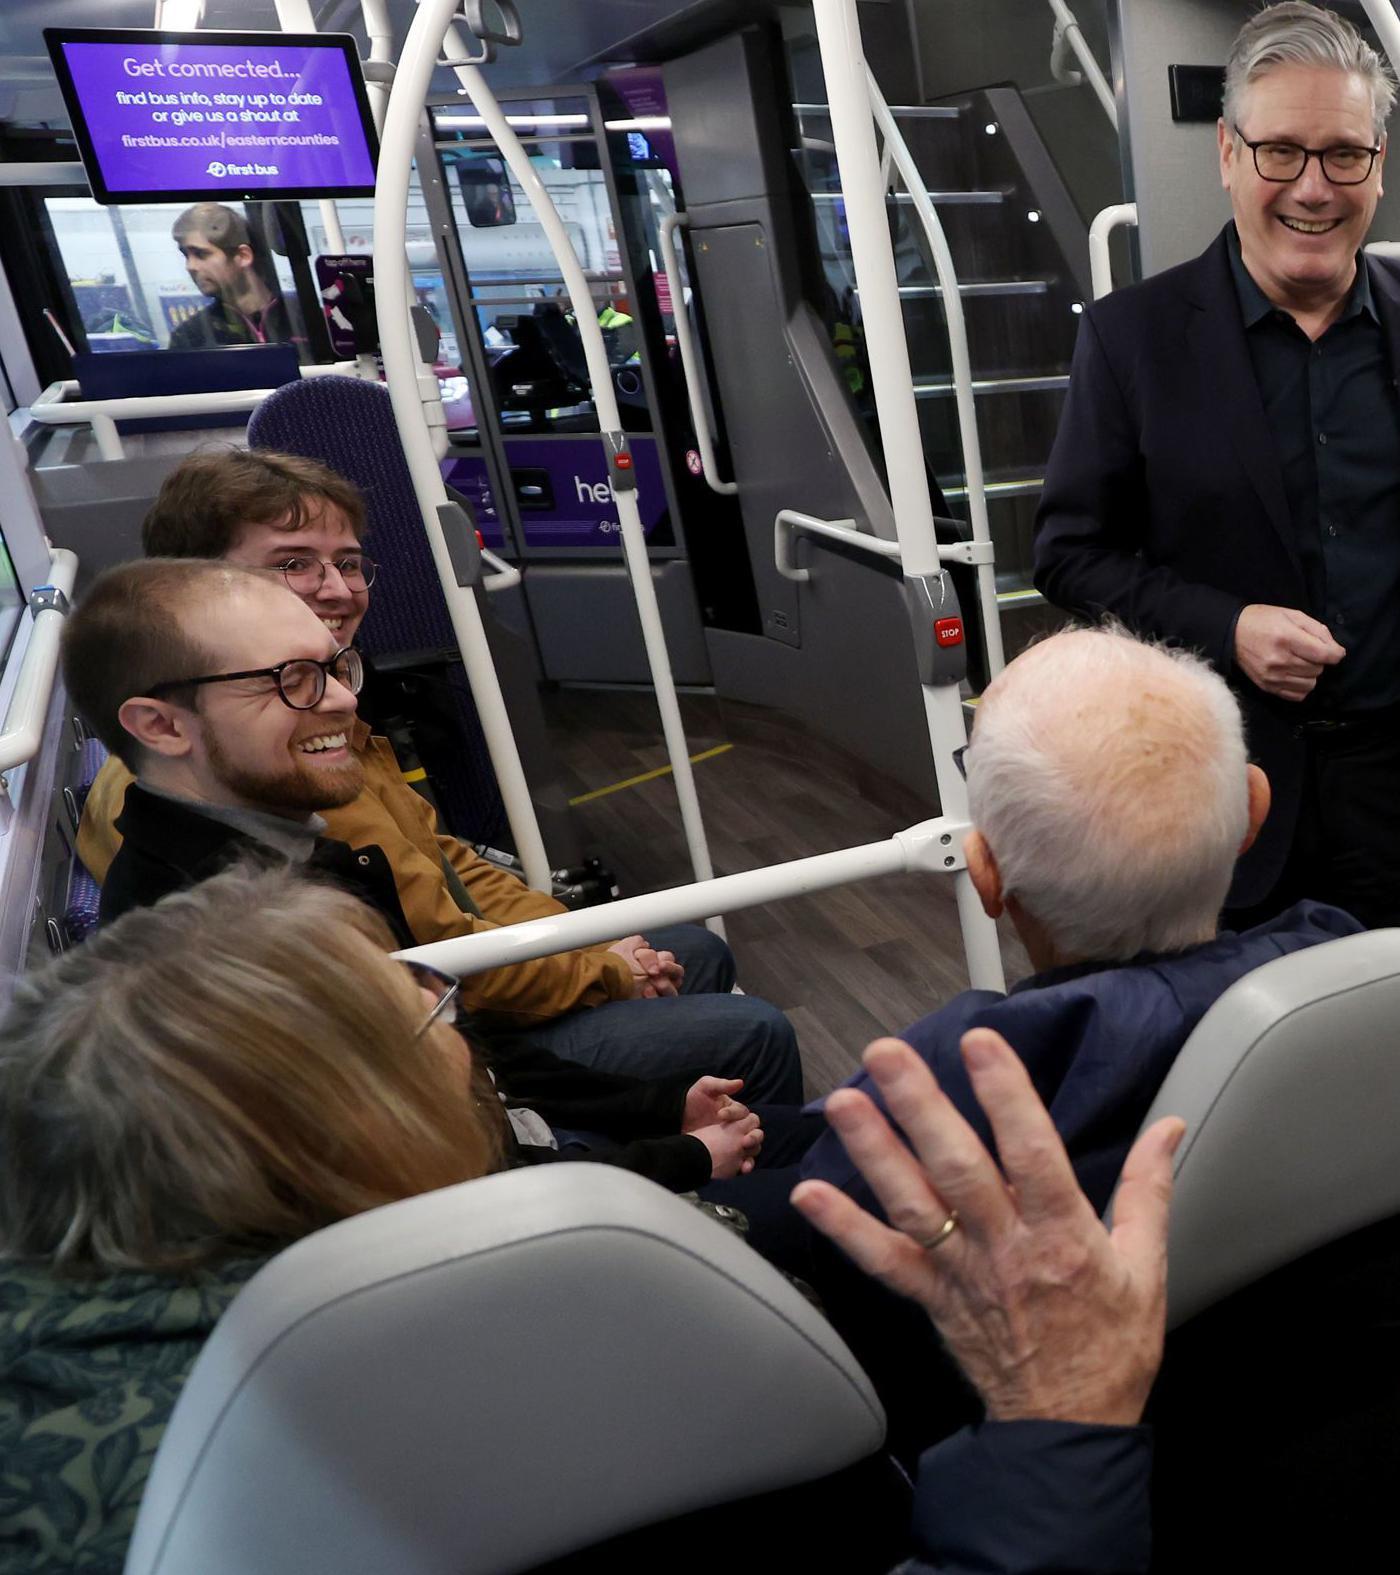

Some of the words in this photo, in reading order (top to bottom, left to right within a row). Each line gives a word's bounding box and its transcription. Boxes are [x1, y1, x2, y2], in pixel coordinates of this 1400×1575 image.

[123, 58, 165, 77] Get
[168, 60, 301, 78] connected...
[116, 91, 146, 105] find
[149, 92, 178, 105] bus
[180, 92, 212, 107] info,
[214, 94, 244, 108] stay
[247, 95, 269, 108] up
[270, 93, 286, 105] to
[288, 92, 323, 105] date
[152, 111, 168, 122] or
[171, 109, 204, 125] give
[206, 112, 224, 122] us
[226, 112, 238, 122] a
[240, 109, 281, 122] shout
[283, 110, 300, 122] at
[121, 131, 339, 148] firstbus.co.uk/easterncounties
[227, 163, 254, 175] first
[255, 163, 279, 175] bus
[941, 628, 959, 638] STOP
